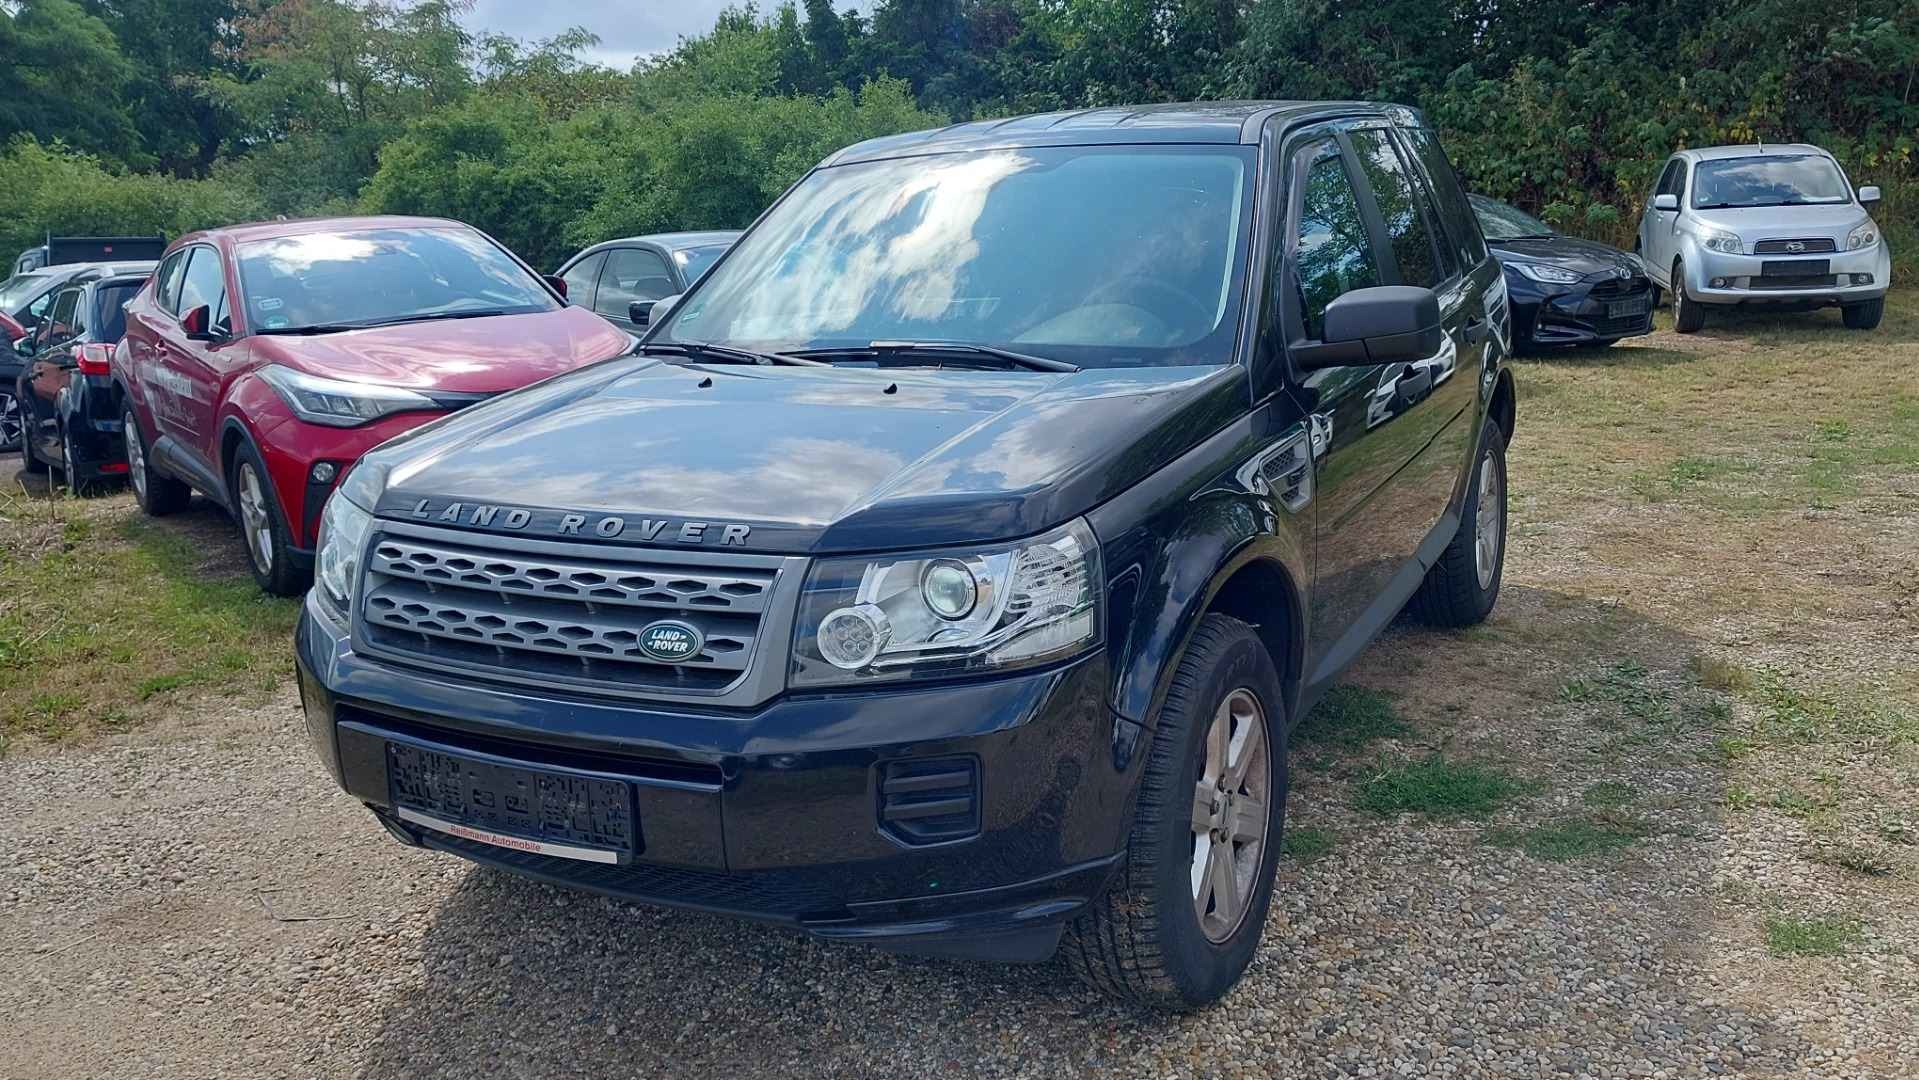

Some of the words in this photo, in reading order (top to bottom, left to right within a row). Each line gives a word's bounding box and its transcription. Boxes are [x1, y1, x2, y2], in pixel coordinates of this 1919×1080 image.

[411, 499, 532, 529] LAND
[558, 513, 751, 546] ROVER
[449, 825, 490, 842] Reißmann
[491, 835, 541, 851] Automobile
